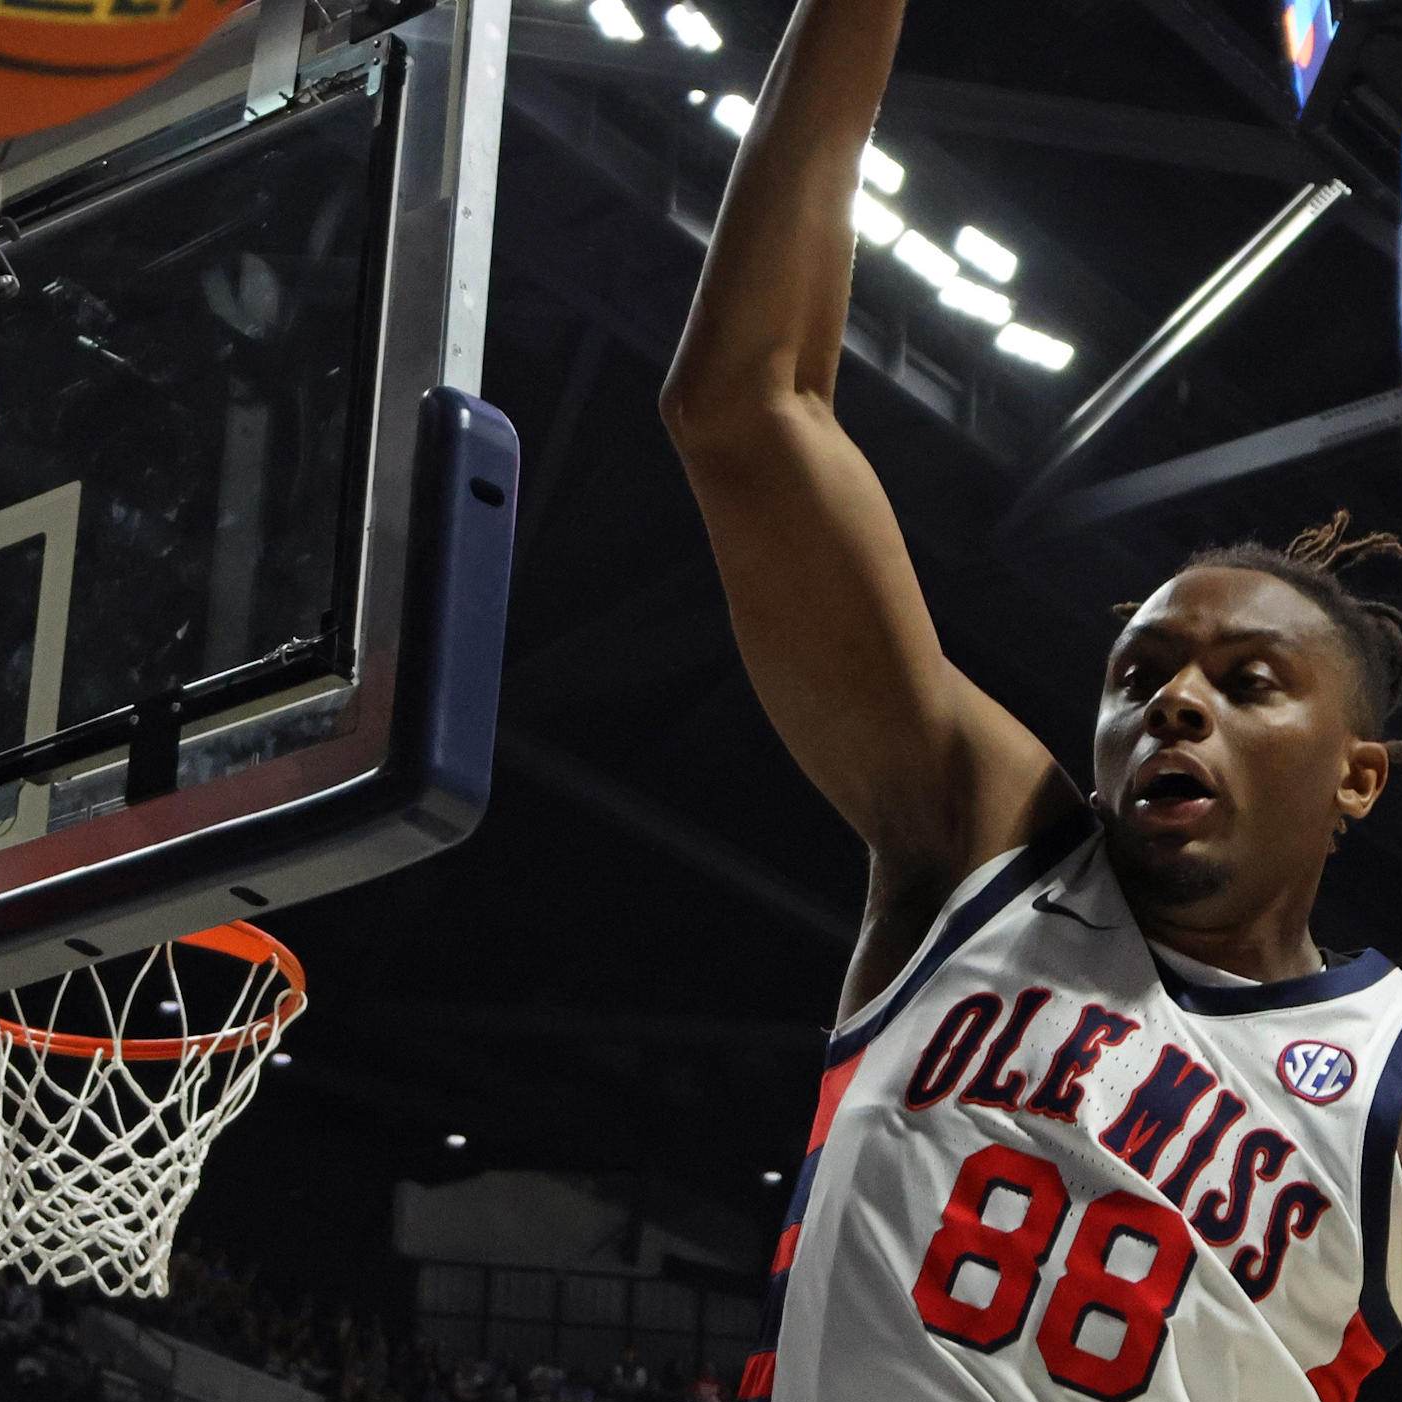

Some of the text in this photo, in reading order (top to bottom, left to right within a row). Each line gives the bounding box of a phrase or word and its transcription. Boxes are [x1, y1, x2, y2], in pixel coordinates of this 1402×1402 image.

[905, 987, 1331, 1303] OLE MISS
[1281, 1043, 1354, 1101] SEC
